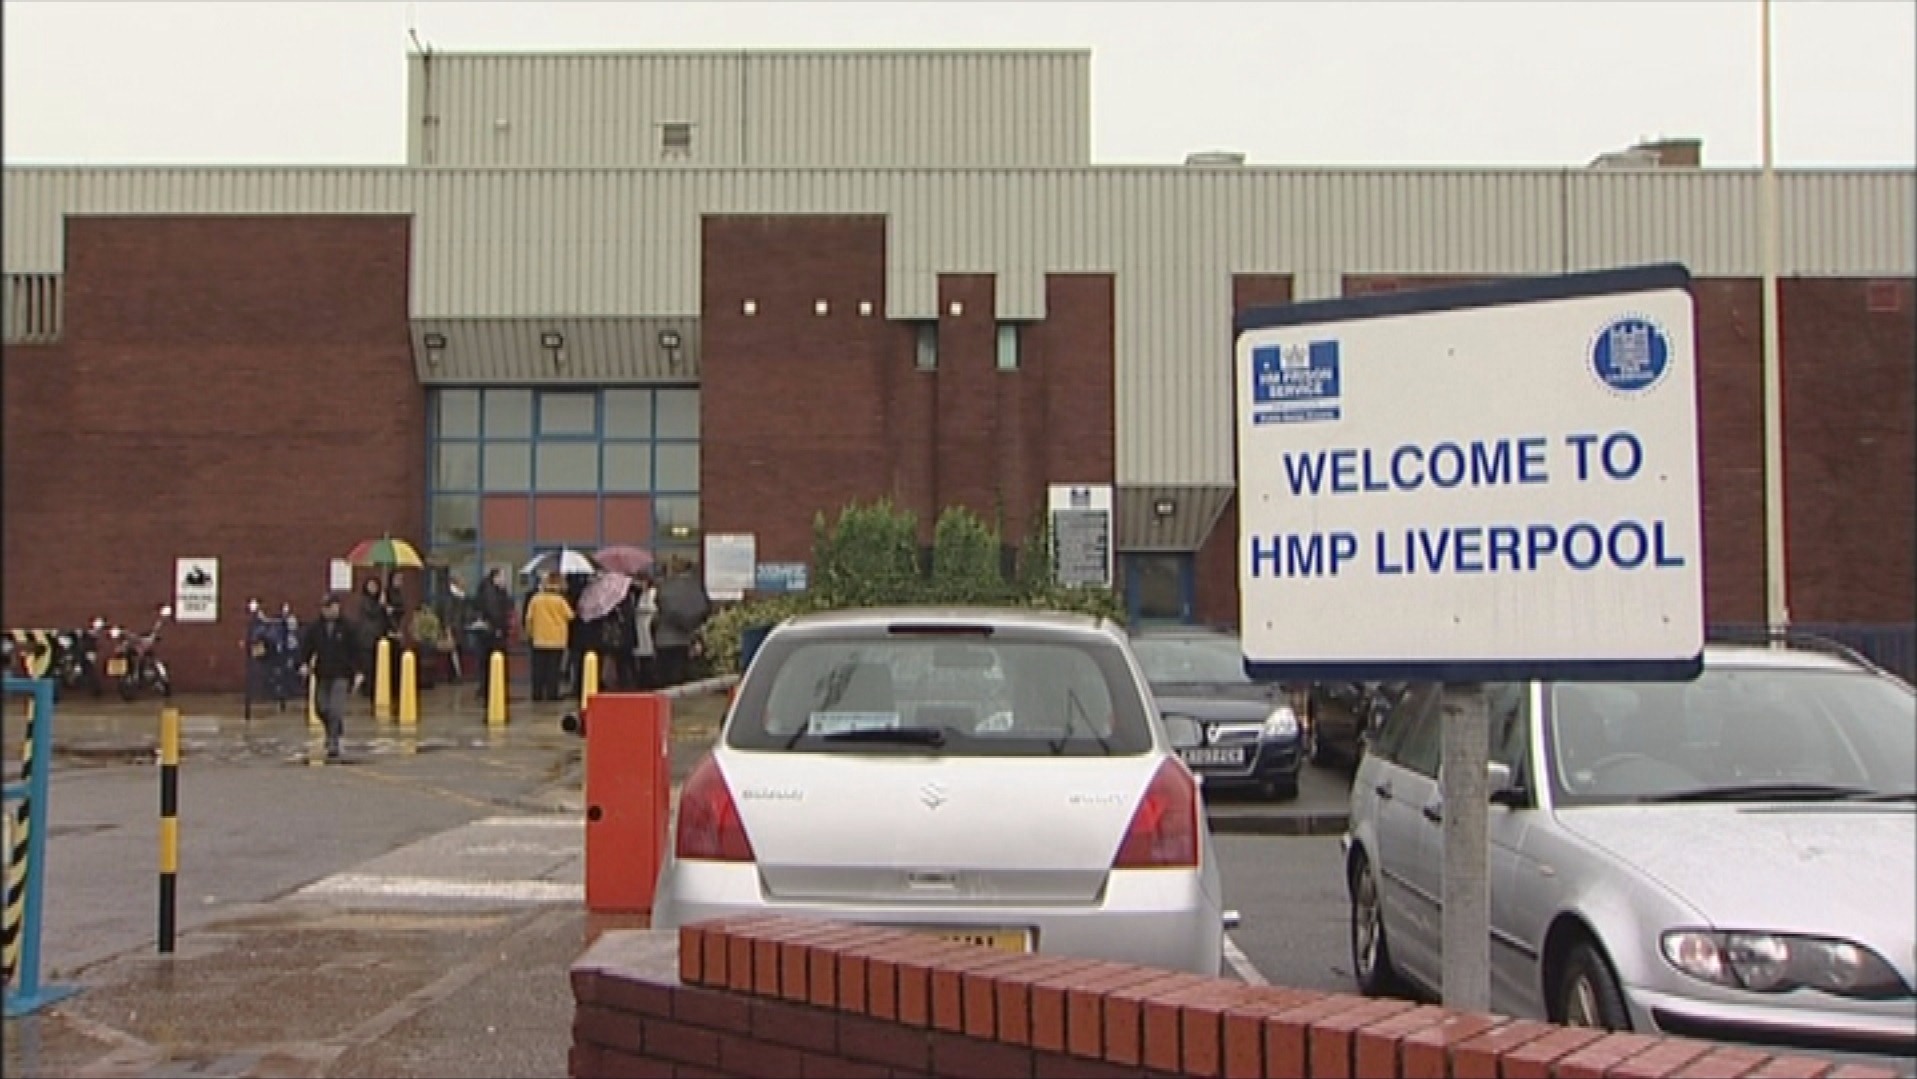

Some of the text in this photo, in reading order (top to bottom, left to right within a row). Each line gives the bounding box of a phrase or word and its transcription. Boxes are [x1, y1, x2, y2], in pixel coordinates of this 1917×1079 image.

[1269, 383, 1323, 397] SERVICE
[1283, 431, 1644, 496] WELCOME TO
[1250, 520, 1685, 578] HMP LIVERPOOL
